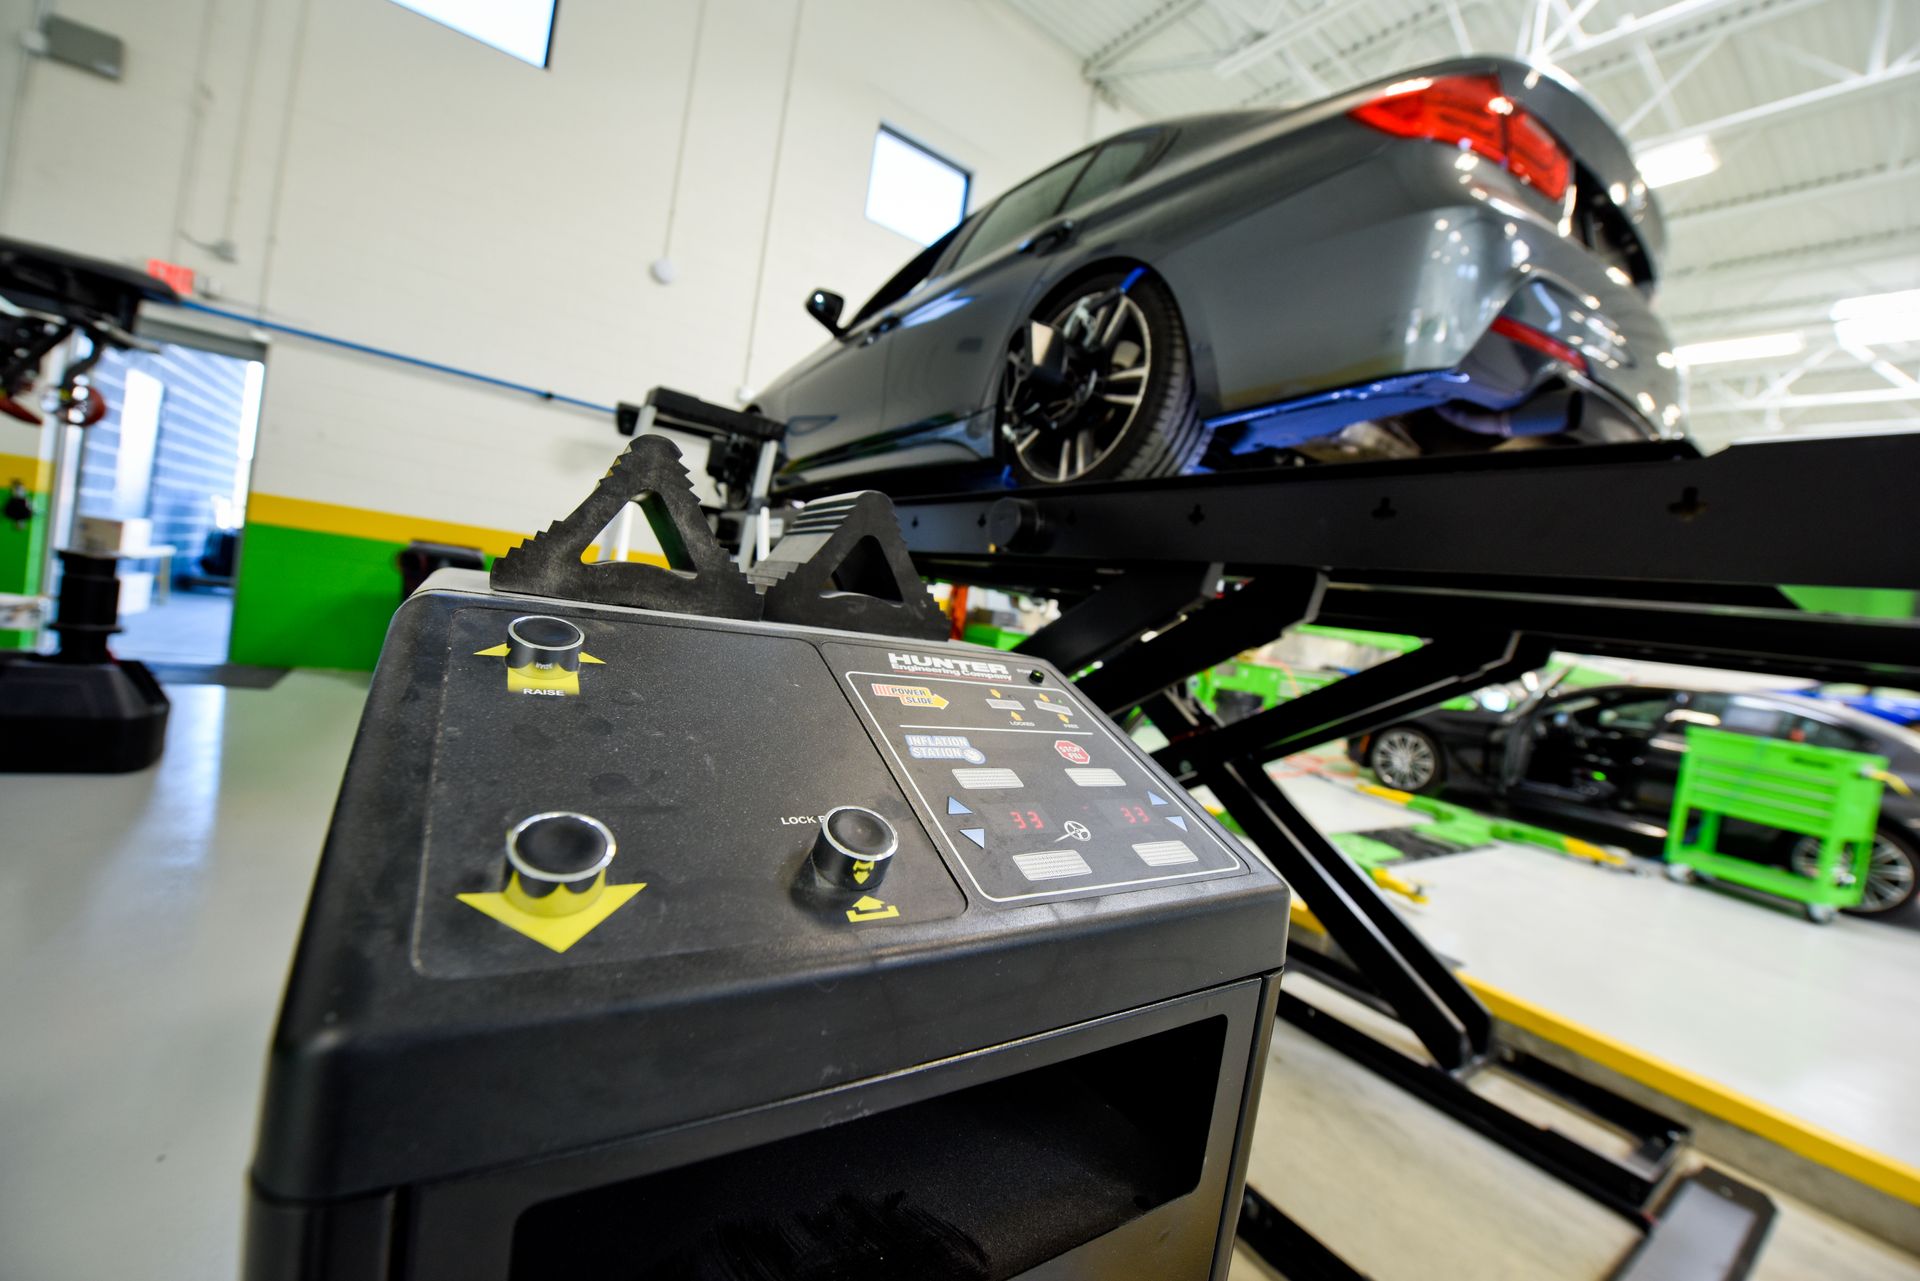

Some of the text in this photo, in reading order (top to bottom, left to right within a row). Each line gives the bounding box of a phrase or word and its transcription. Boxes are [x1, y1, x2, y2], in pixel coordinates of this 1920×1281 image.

[888, 652, 1009, 674] HUNTER
[891, 663, 961, 677] Engineering
[961, 668, 1012, 681] Company
[523, 688, 565, 696] RAISE
[890, 687, 927, 696] POWER
[905, 696, 934, 705] SLIDE
[908, 736, 968, 747] INFLATION
[912, 747, 962, 757] STATION
[1058, 745, 1081, 754] STOP
[781, 816, 817, 825] LOCK
[1009, 811, 1044, 830] 33
